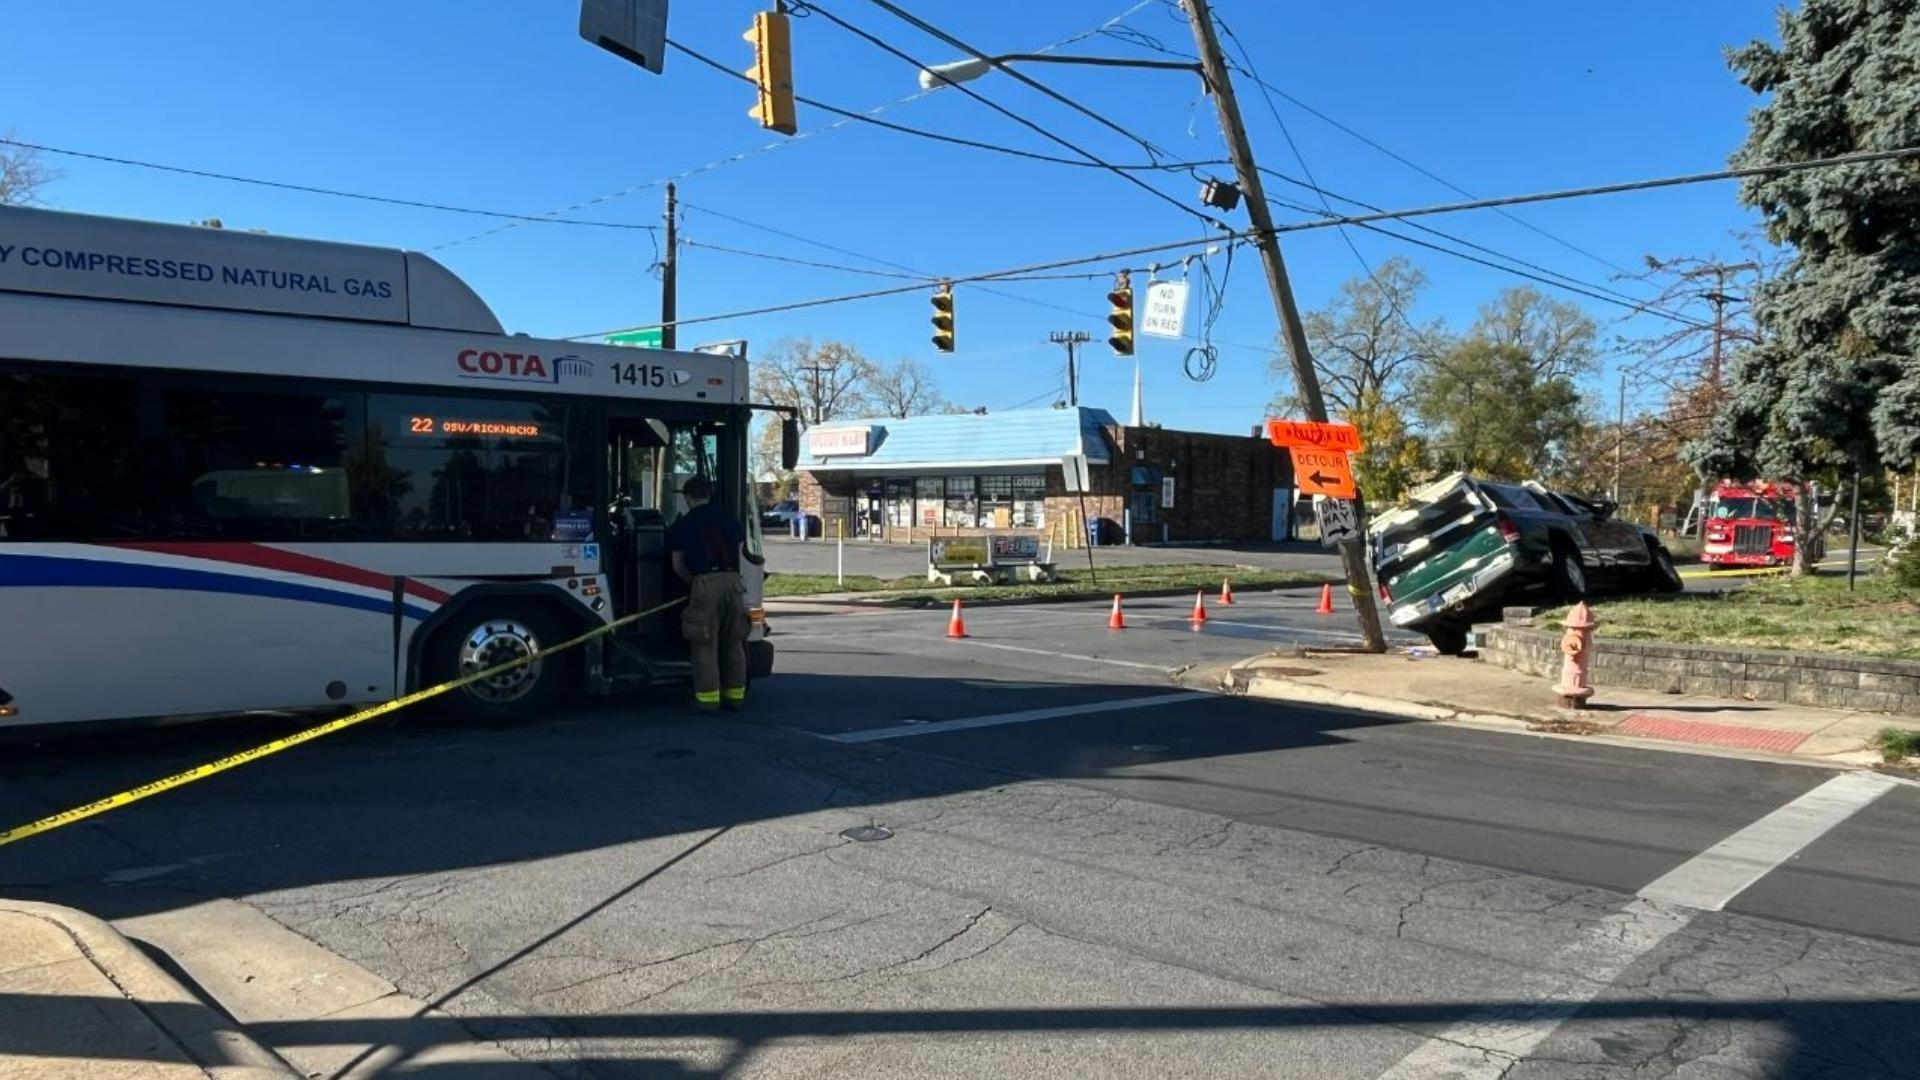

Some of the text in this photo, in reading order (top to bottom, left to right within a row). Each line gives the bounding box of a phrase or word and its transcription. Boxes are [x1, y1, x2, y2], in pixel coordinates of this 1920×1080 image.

[21, 247, 213, 282] COMPRESSED
[222, 266, 336, 294] NATURAL
[343, 278, 392, 299] GAS
[1160, 288, 1175, 299] NO
[457, 349, 547, 378] COTA
[610, 362, 665, 388] 1415
[411, 418, 433, 432] 22
[1298, 454, 1343, 468] DETOUR
[1322, 499, 1347, 513] ONE
[1324, 511, 1349, 527] WAY
